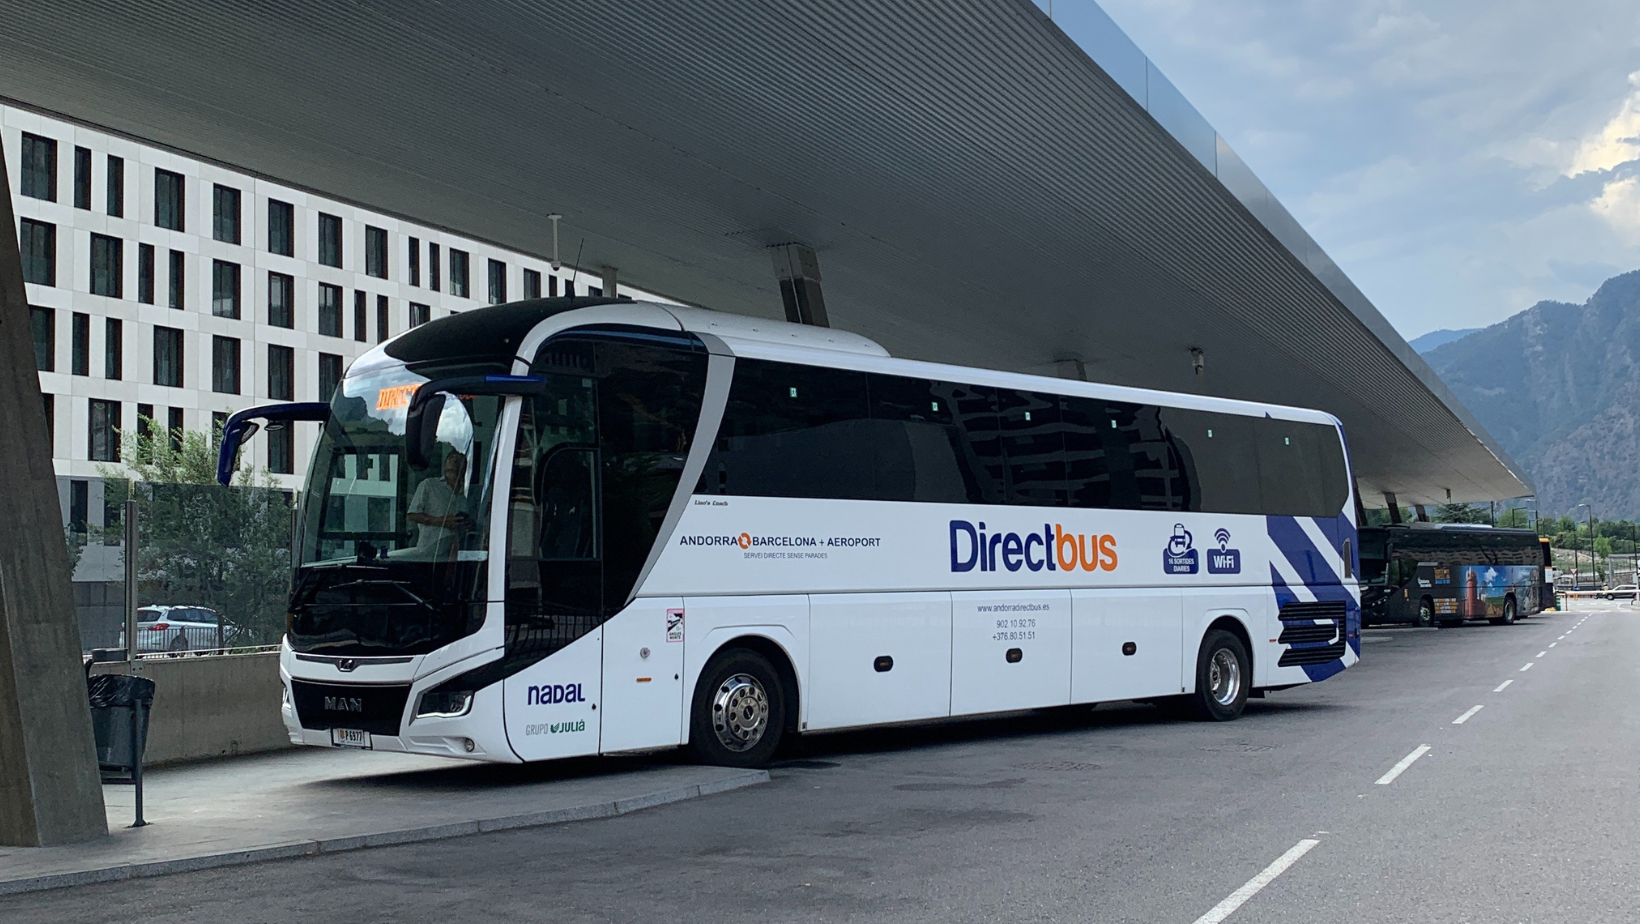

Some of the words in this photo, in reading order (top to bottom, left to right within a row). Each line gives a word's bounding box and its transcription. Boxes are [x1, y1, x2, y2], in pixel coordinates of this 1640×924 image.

[680, 536, 738, 546] ANDORRA
[753, 537, 817, 547] BARCELONA
[827, 537, 881, 547] AEROPORT
[949, 520, 1118, 572] Directbus
[992, 631, 1036, 641] +376.80.51.51
[324, 696, 362, 712] MAN
[525, 723, 549, 736] GRUPO
